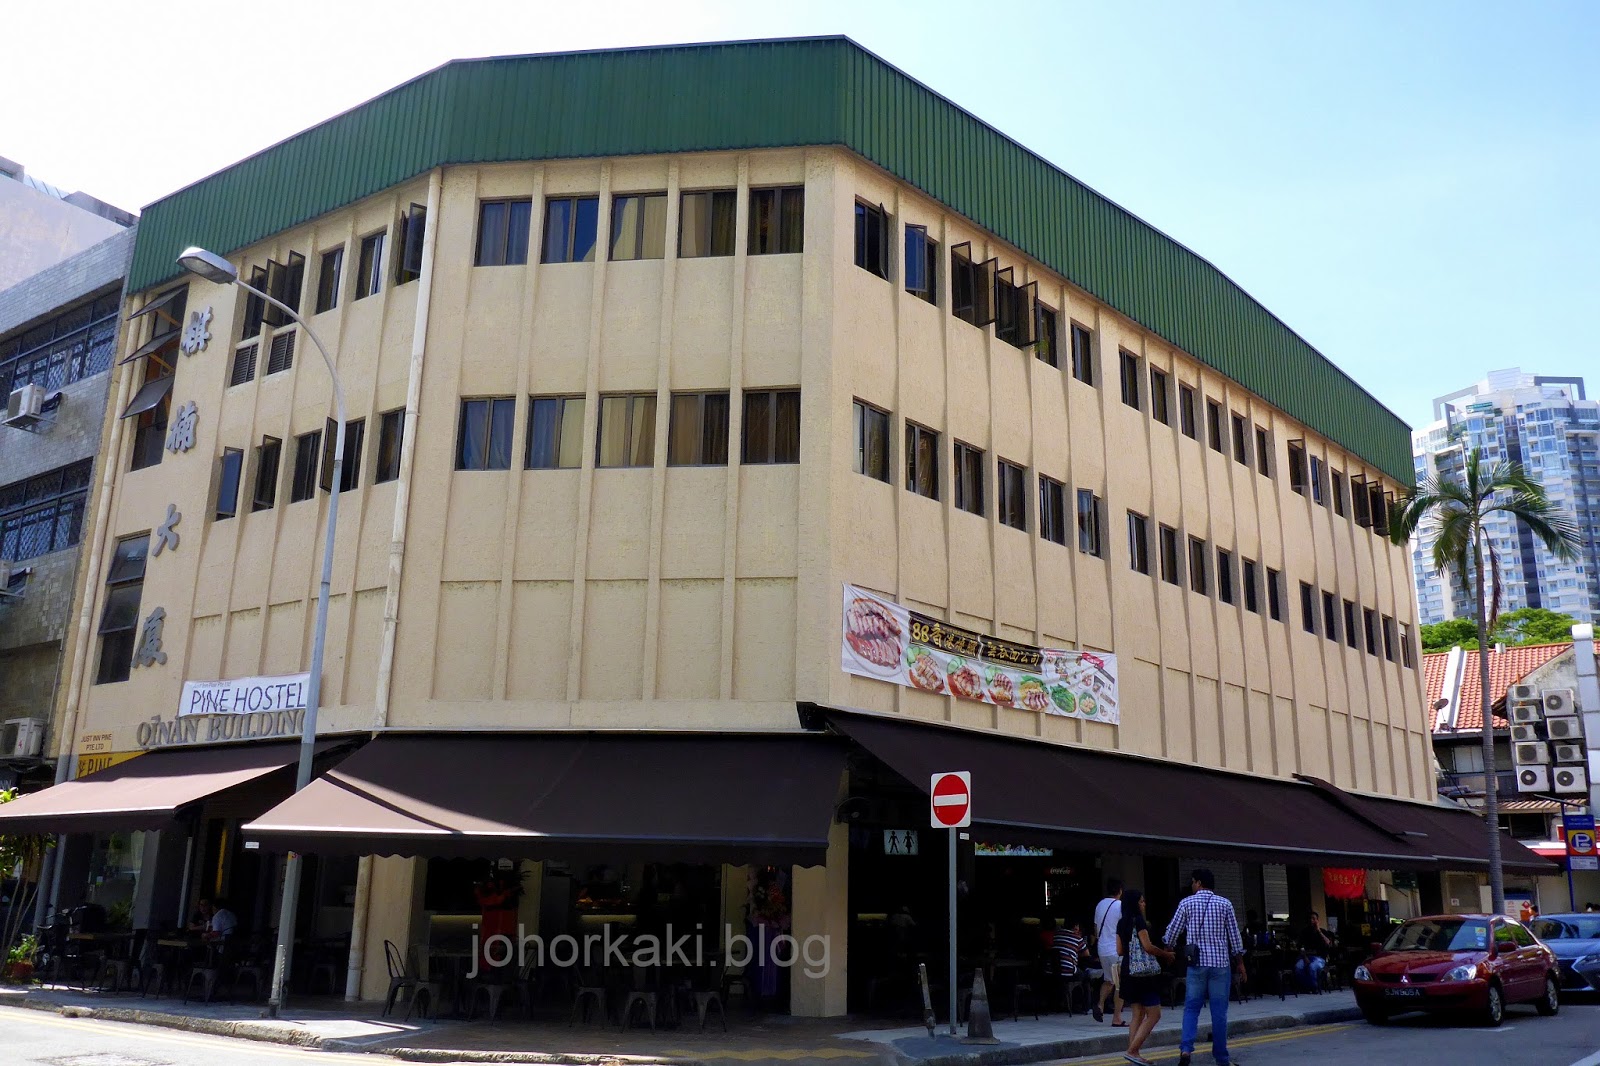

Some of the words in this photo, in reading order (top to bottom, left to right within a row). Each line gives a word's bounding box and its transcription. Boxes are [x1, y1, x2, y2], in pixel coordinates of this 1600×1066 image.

[190, 688, 231, 713] PINE
[233, 682, 306, 711] HOSTEL
[101, 733, 112, 741] PINE
